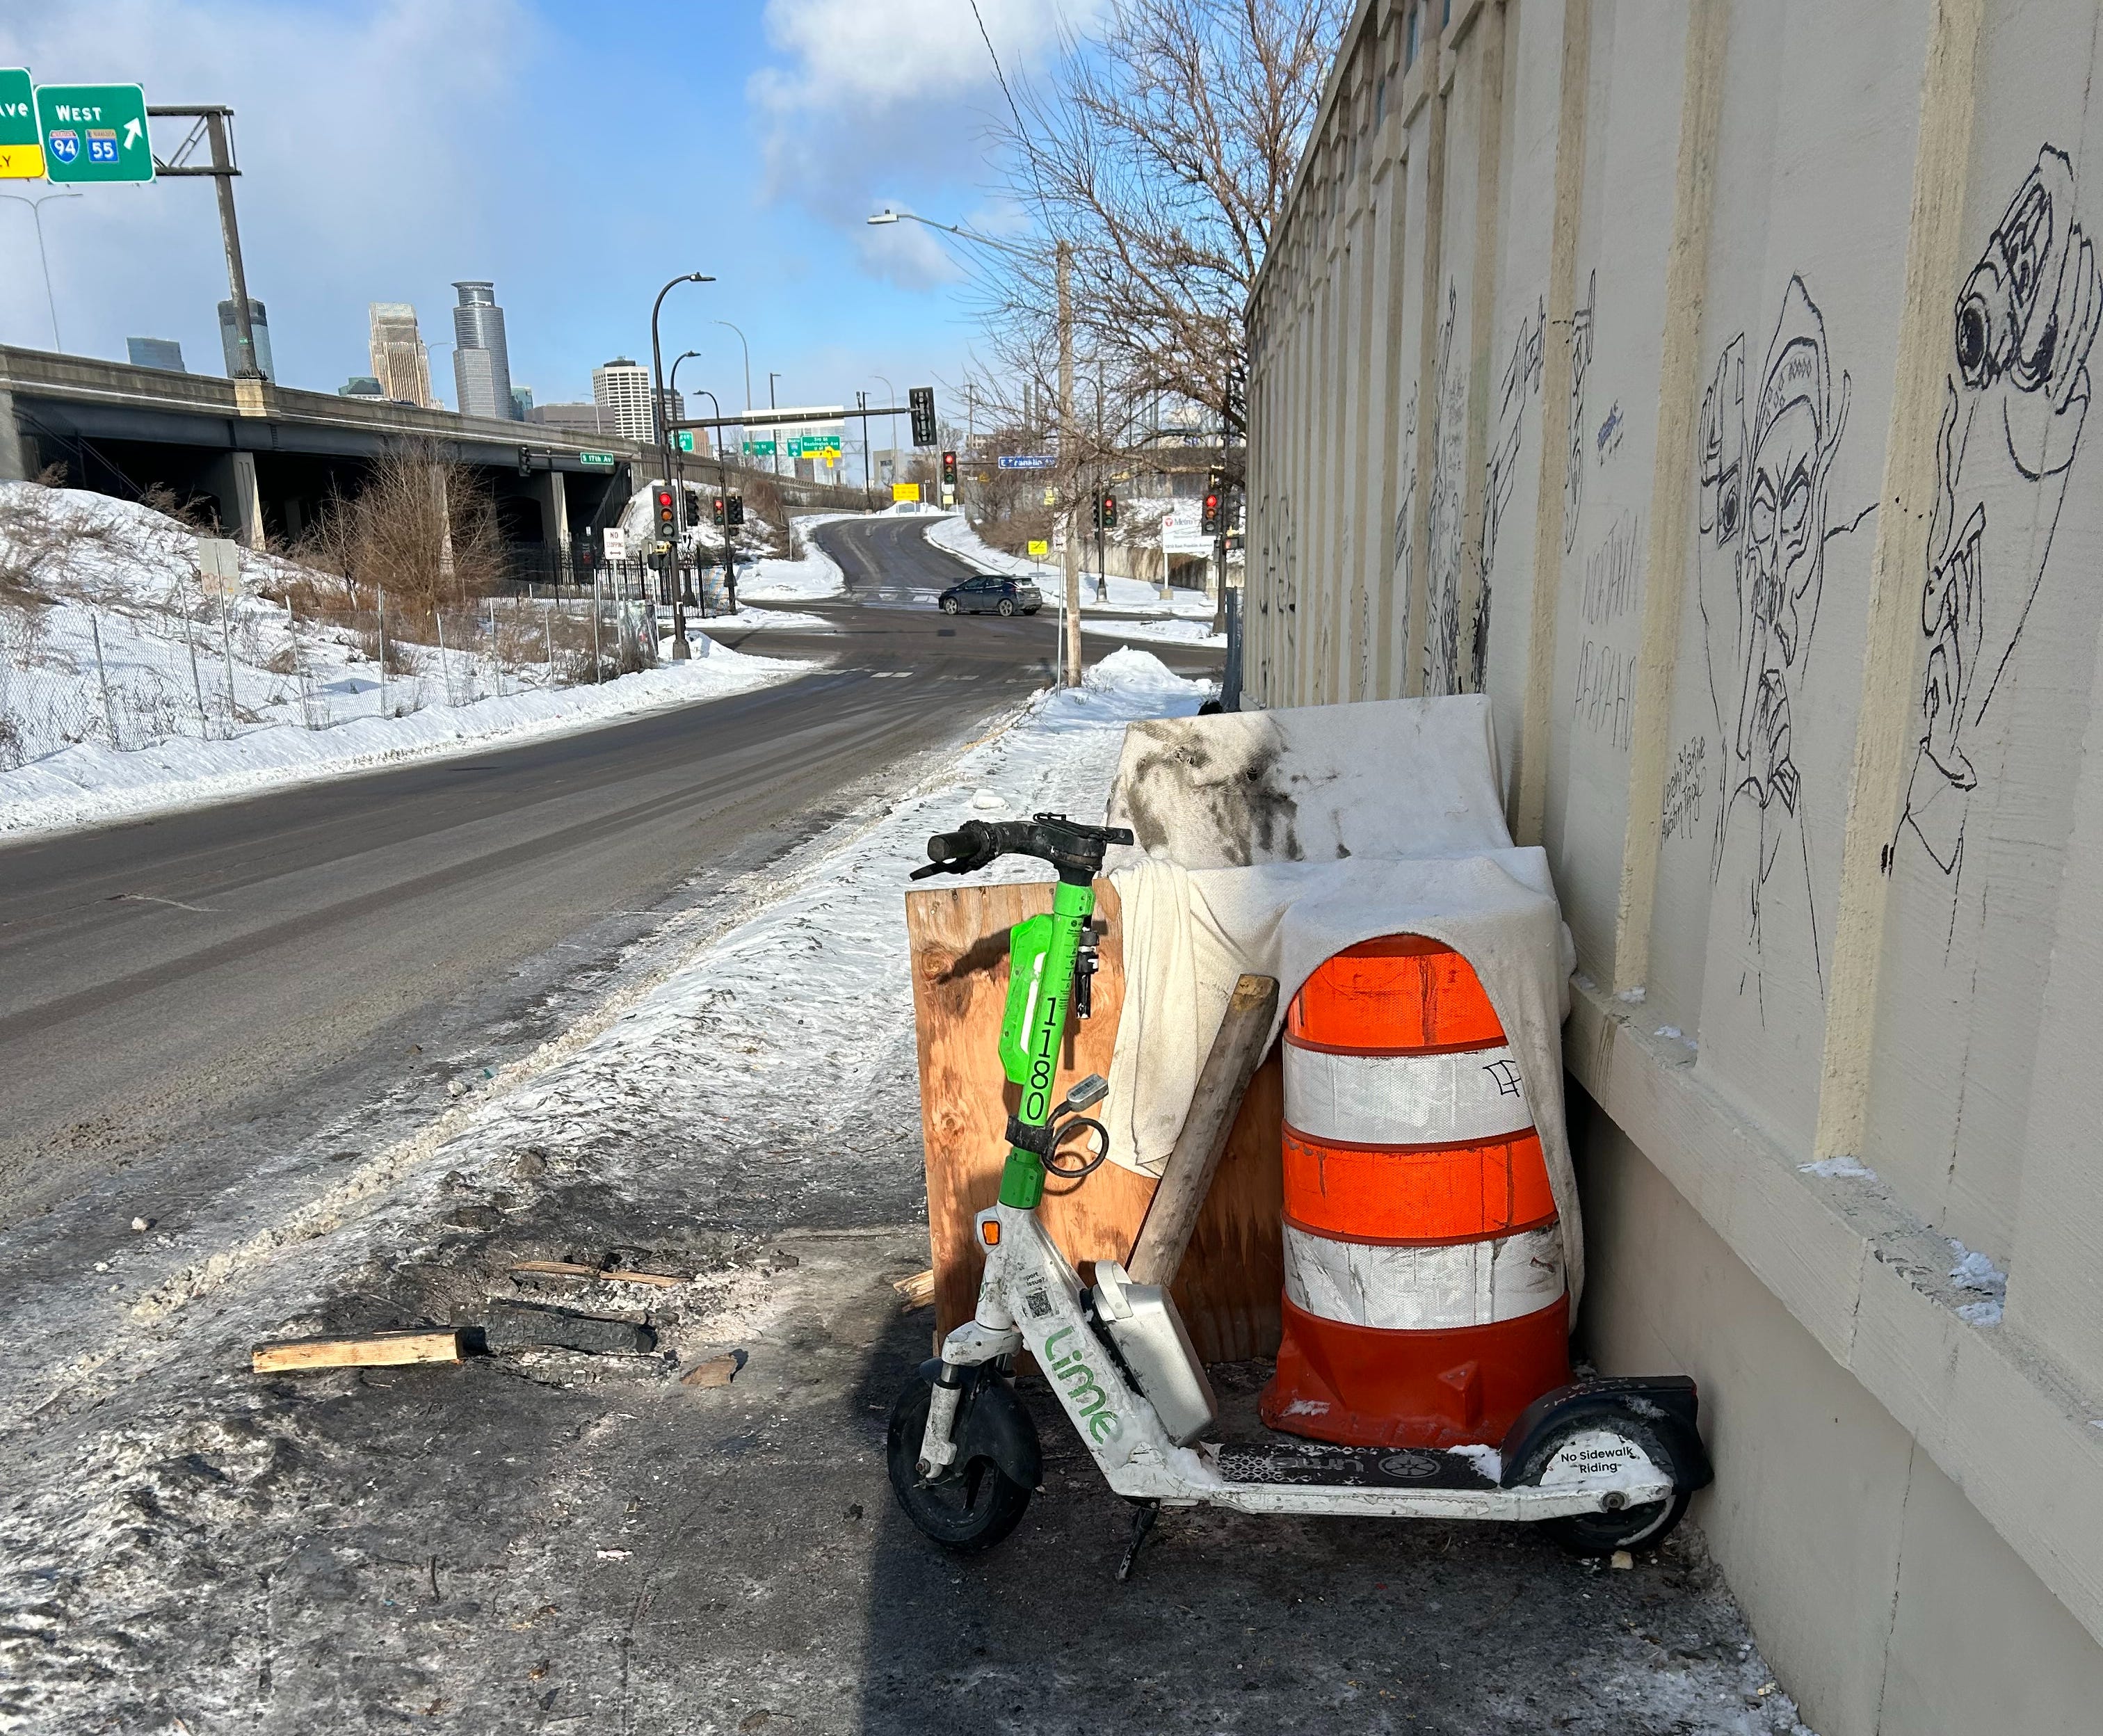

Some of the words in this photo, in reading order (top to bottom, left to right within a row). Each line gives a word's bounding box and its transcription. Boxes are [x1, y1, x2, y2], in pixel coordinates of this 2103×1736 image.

[55, 104, 102, 122] WEST
[54, 139, 76, 156] 94
[92, 141, 115, 159] 55
[0, 155, 11, 168] Y
[1026, 997, 1057, 1121] 1180
[1026, 1276, 1045, 1287] issue?
[1045, 1325, 1122, 1445] Lime
[1561, 1454, 1577, 1462] No
[1579, 1446, 1634, 1461] Sidewalk
[1579, 1462, 1618, 1474] Riding
